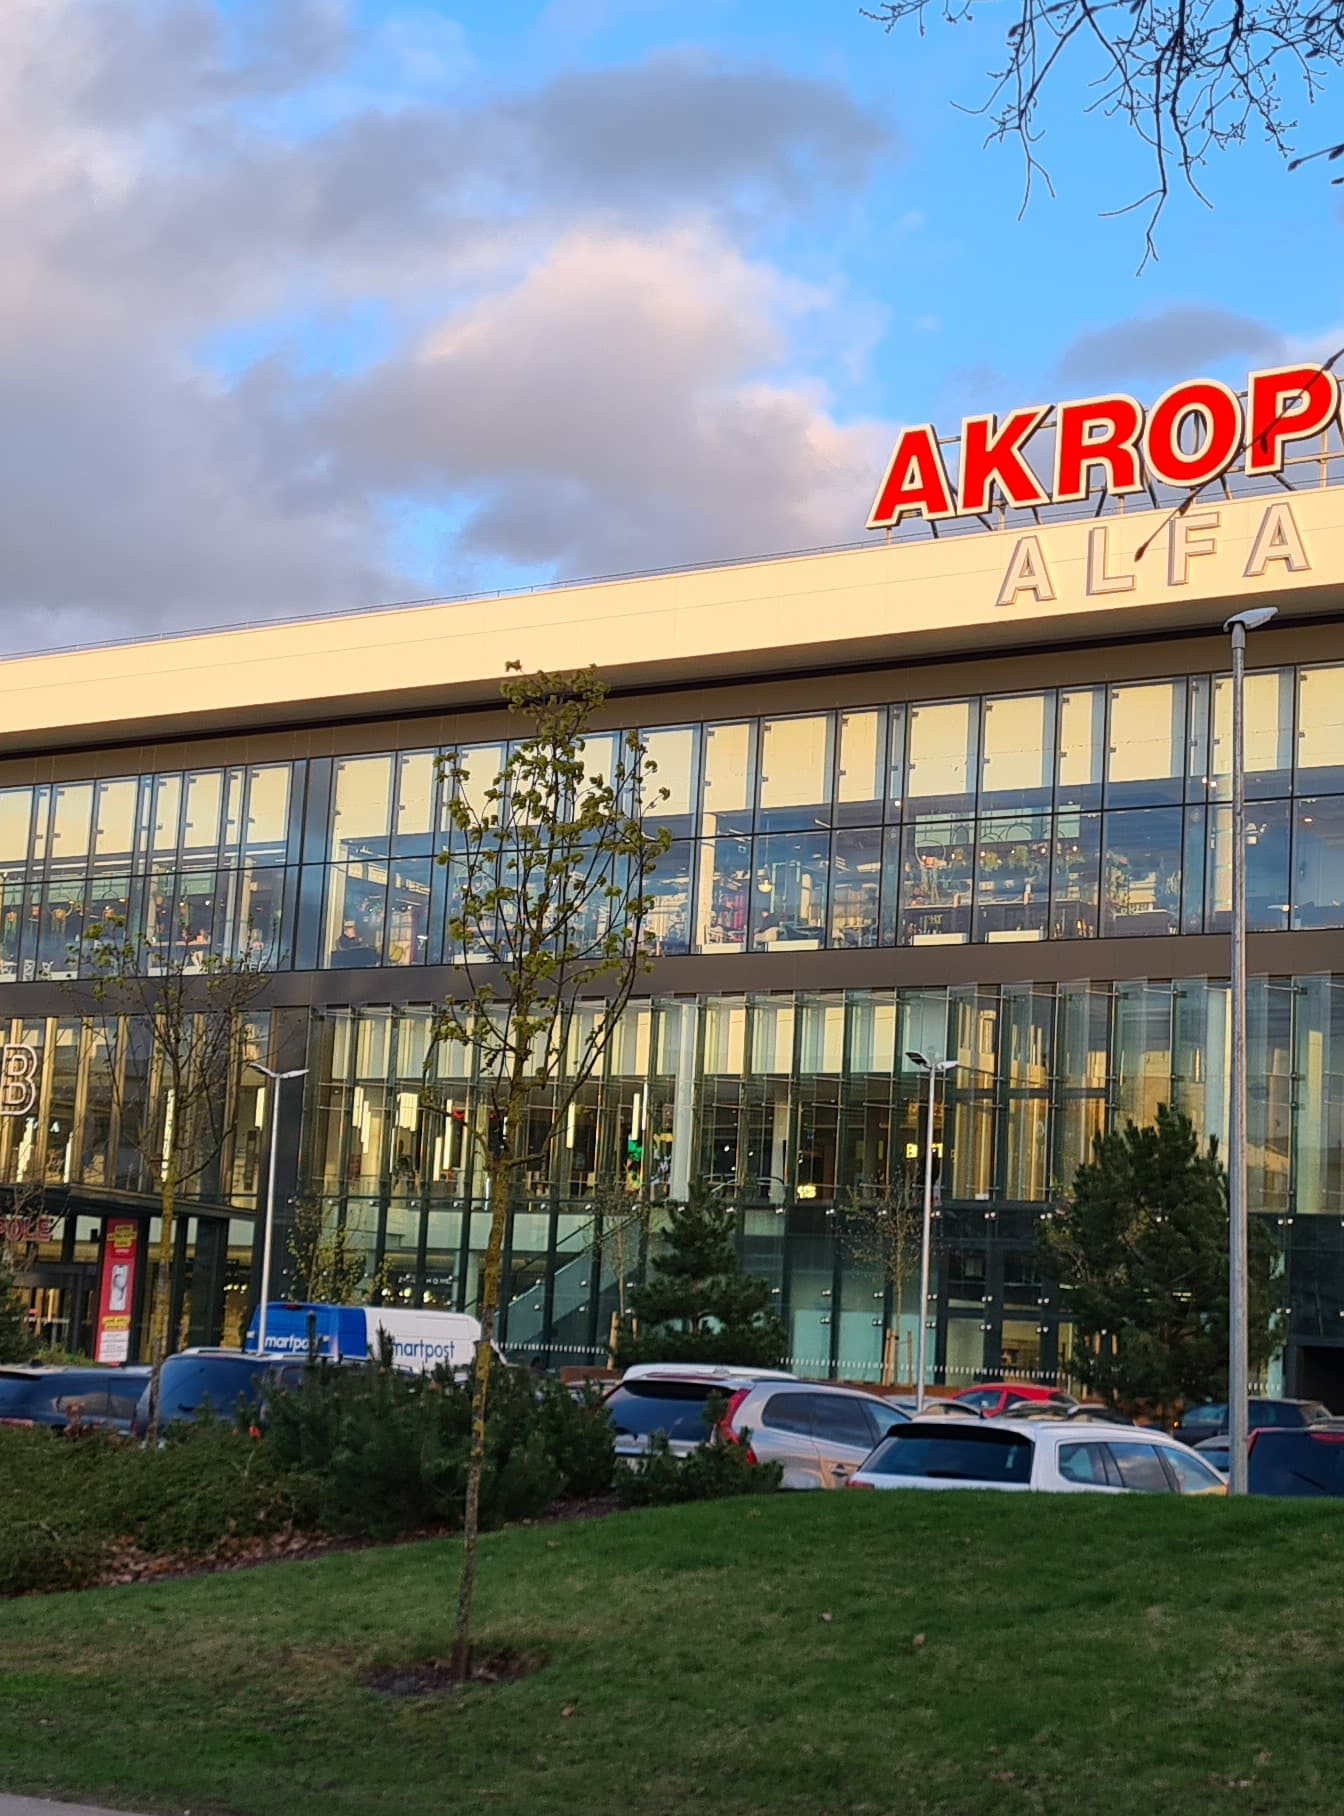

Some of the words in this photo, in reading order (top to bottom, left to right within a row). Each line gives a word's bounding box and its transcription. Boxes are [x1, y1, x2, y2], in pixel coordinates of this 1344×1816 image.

[995, 502, 1313, 607] ALFA
[263, 1334, 314, 1353] martpo
[392, 1339, 455, 1363] martpost
